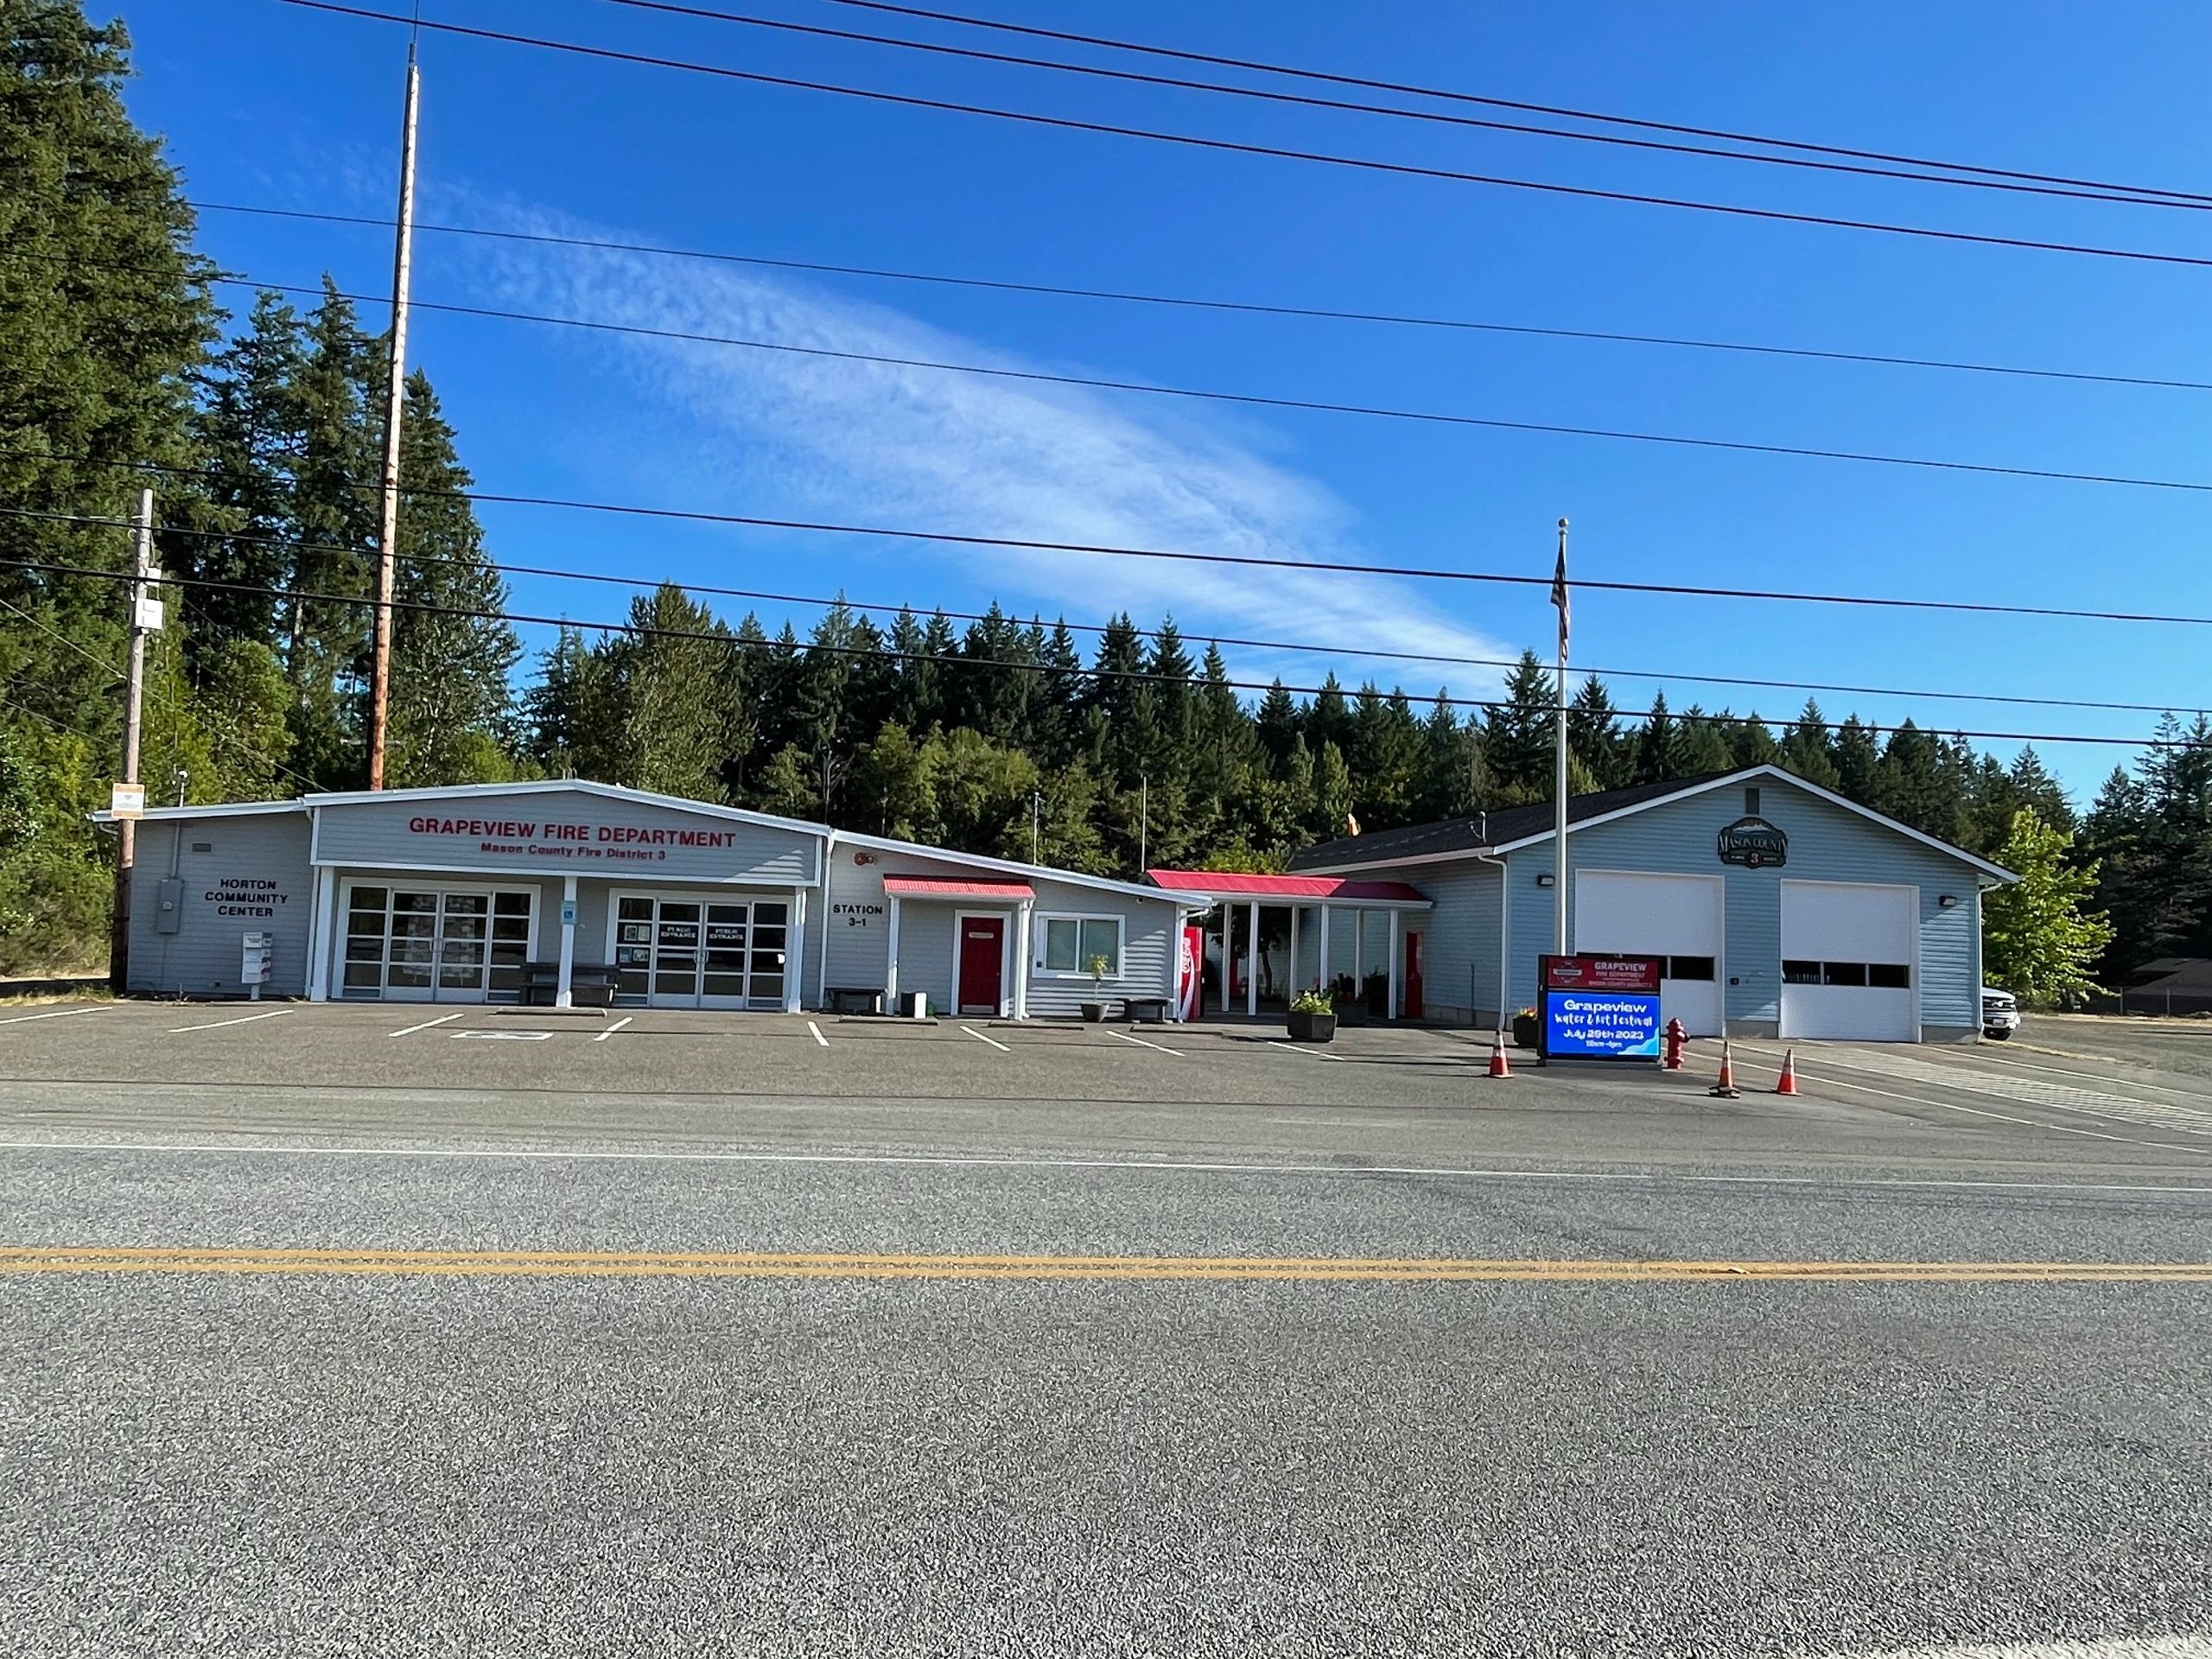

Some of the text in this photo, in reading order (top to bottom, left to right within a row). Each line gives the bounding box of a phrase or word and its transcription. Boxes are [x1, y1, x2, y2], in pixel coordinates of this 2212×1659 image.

[409, 817, 736, 848] GRAPEVIEW FIRE DEPARTMENT
[480, 842, 666, 861] Mason County Fire District 3
[1750, 852, 1759, 864] 3
[220, 879, 276, 890] HORTON
[204, 891, 289, 904] COMMUNITY
[218, 905, 274, 917] CENTER
[833, 904, 883, 915] STATION
[849, 917, 867, 927] 3-1
[1594, 961, 1647, 972] GRAPEVIEW
[1563, 999, 1647, 1014] Grapeview
[1563, 1028, 1586, 1040] July
[1615, 1030, 1644, 1039] 2023
